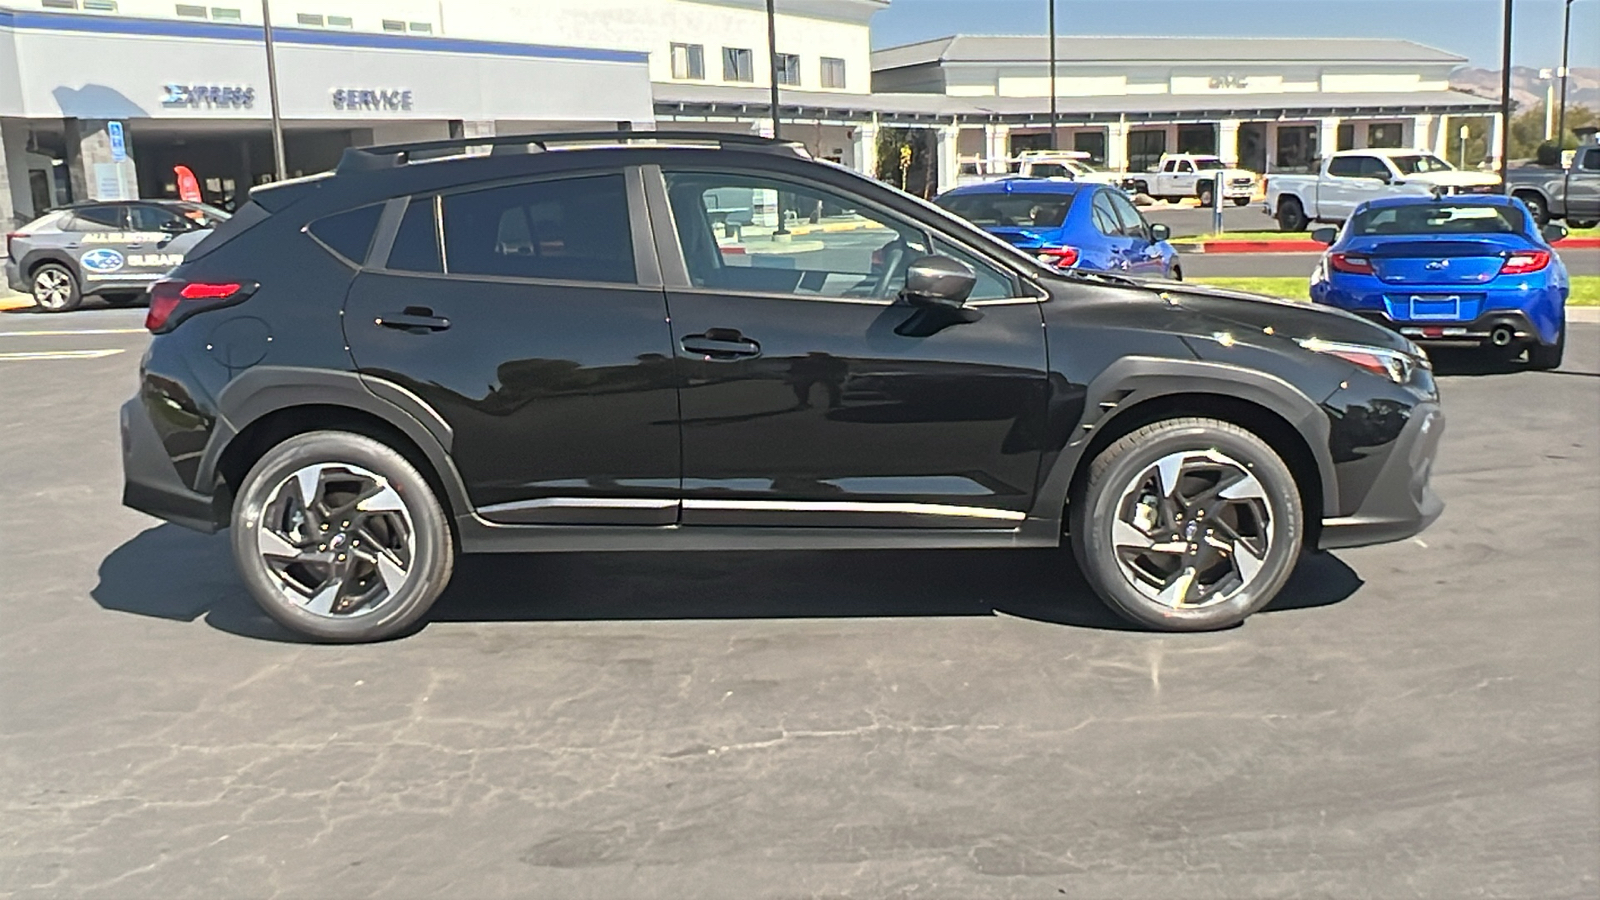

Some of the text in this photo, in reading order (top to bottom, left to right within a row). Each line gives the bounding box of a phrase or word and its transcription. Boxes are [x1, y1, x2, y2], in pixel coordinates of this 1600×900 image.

[162, 84, 255, 109] EXPRESS
[333, 88, 413, 111] SERVICE
[127, 254, 184, 267] SUBAR
